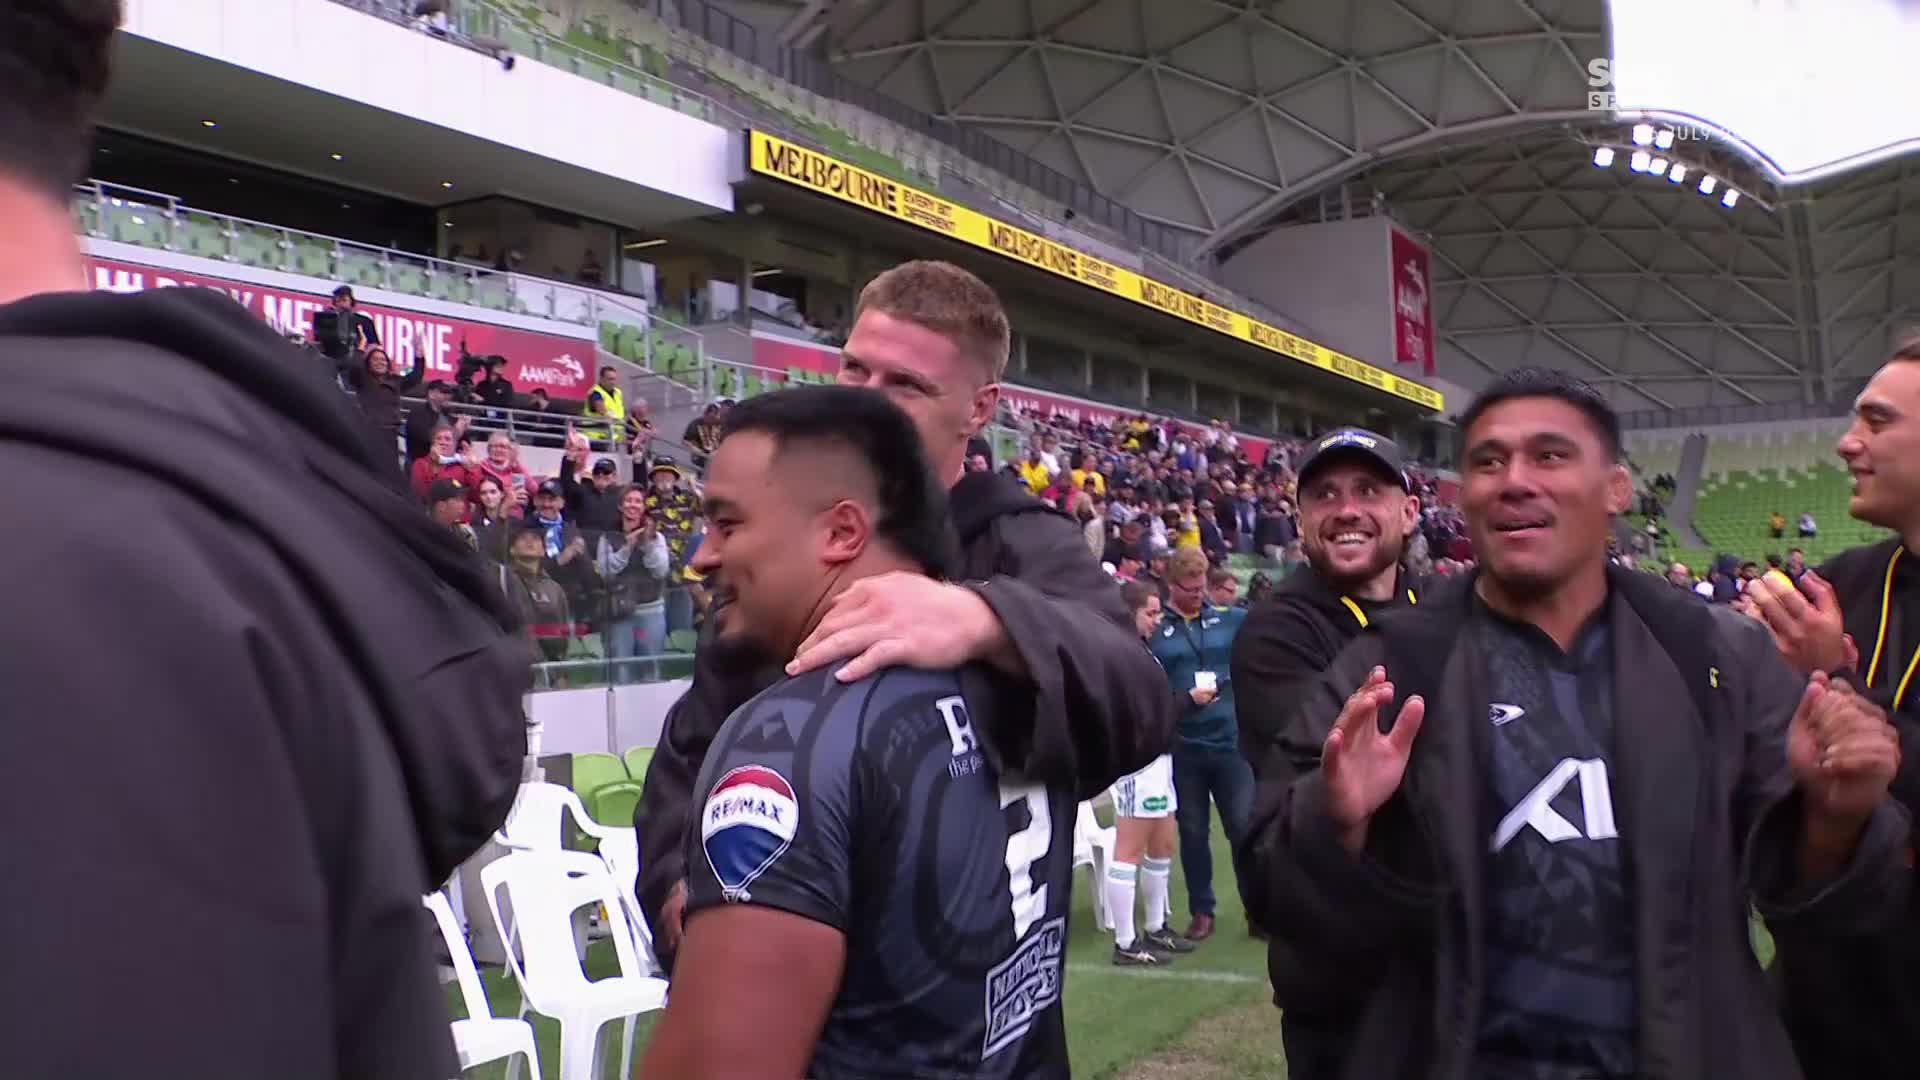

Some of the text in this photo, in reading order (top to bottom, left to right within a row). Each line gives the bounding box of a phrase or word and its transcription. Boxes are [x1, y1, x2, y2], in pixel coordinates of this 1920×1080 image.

[766, 139, 897, 213] MELBOURNE
[987, 220, 1077, 276] MELBOURNE
[948, 757, 969, 778] the
[711, 797, 784, 825] RE/MAX
